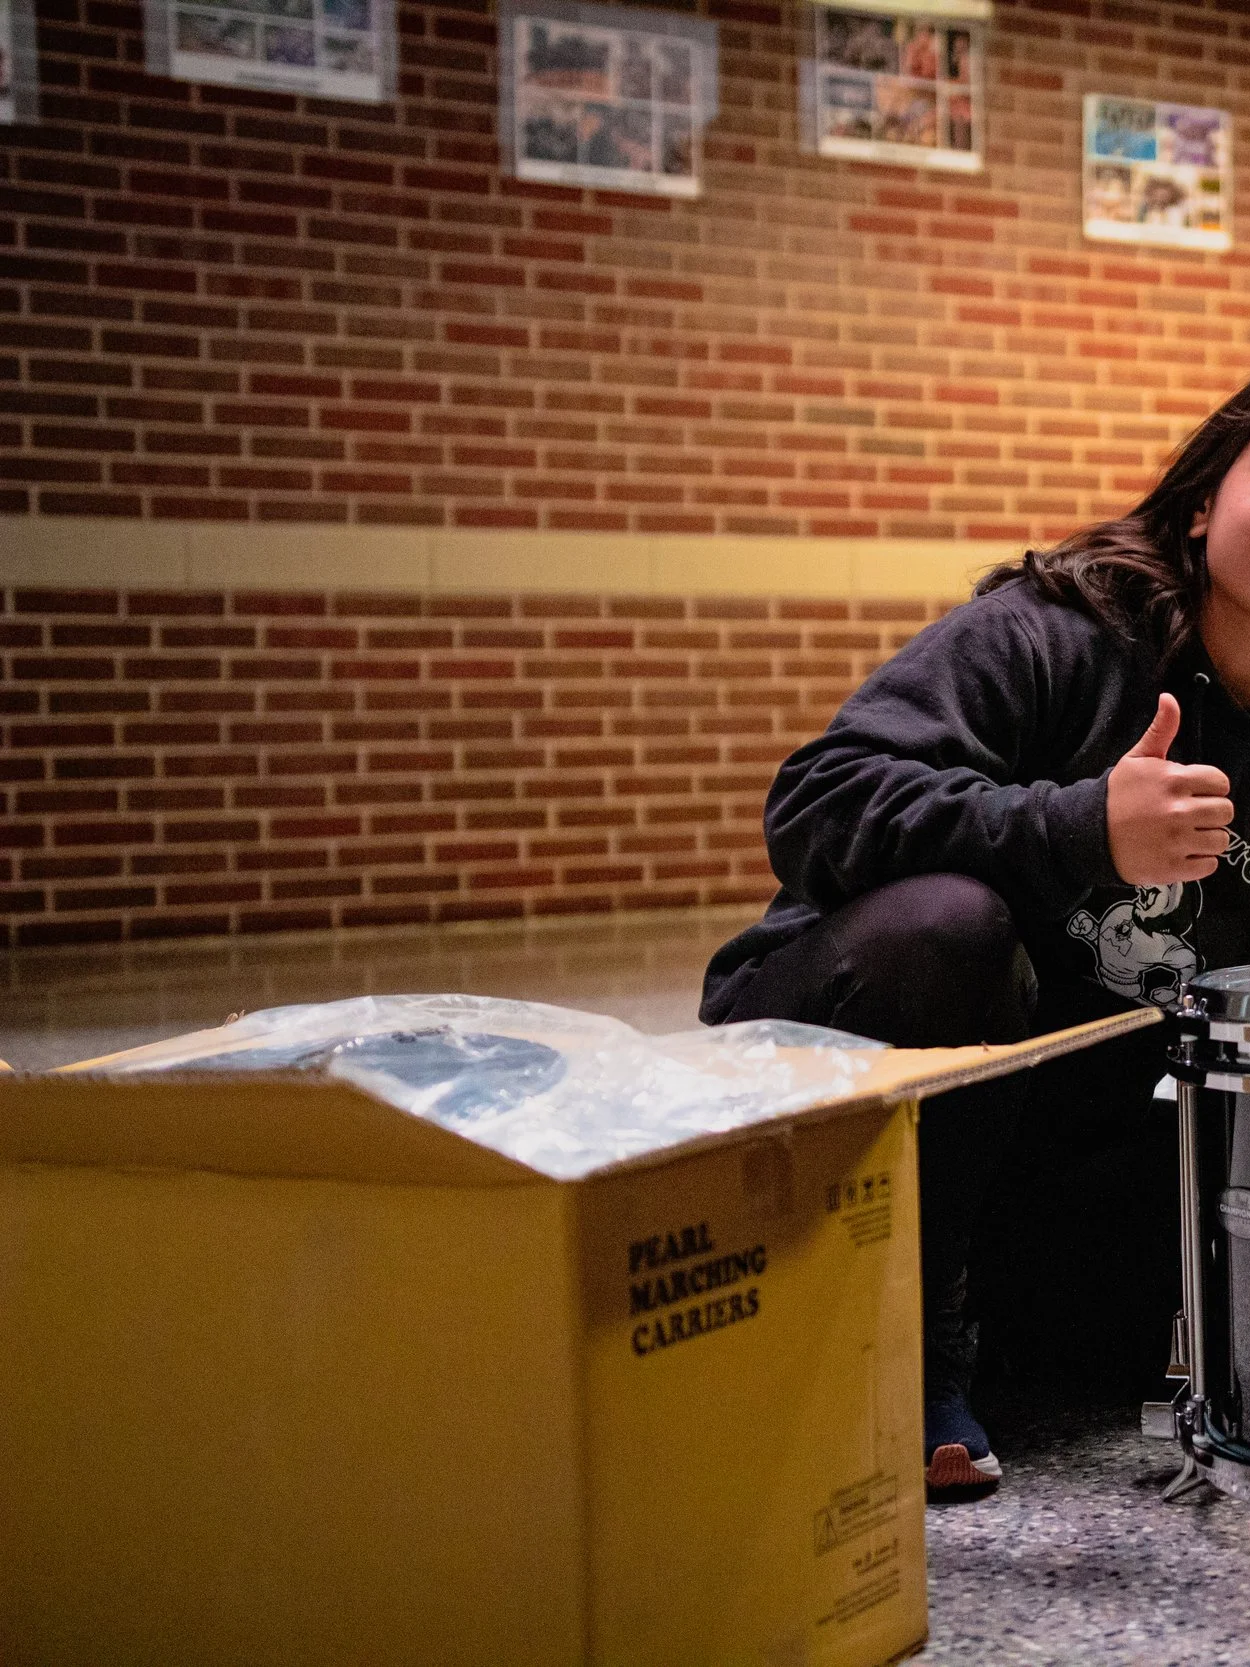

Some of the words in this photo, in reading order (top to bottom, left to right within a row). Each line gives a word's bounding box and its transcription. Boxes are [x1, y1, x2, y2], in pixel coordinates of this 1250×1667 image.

[628, 1221, 716, 1275] PEARL
[630, 1244, 767, 1316] MARCHING
[632, 1288, 760, 1356] CARRIERS
